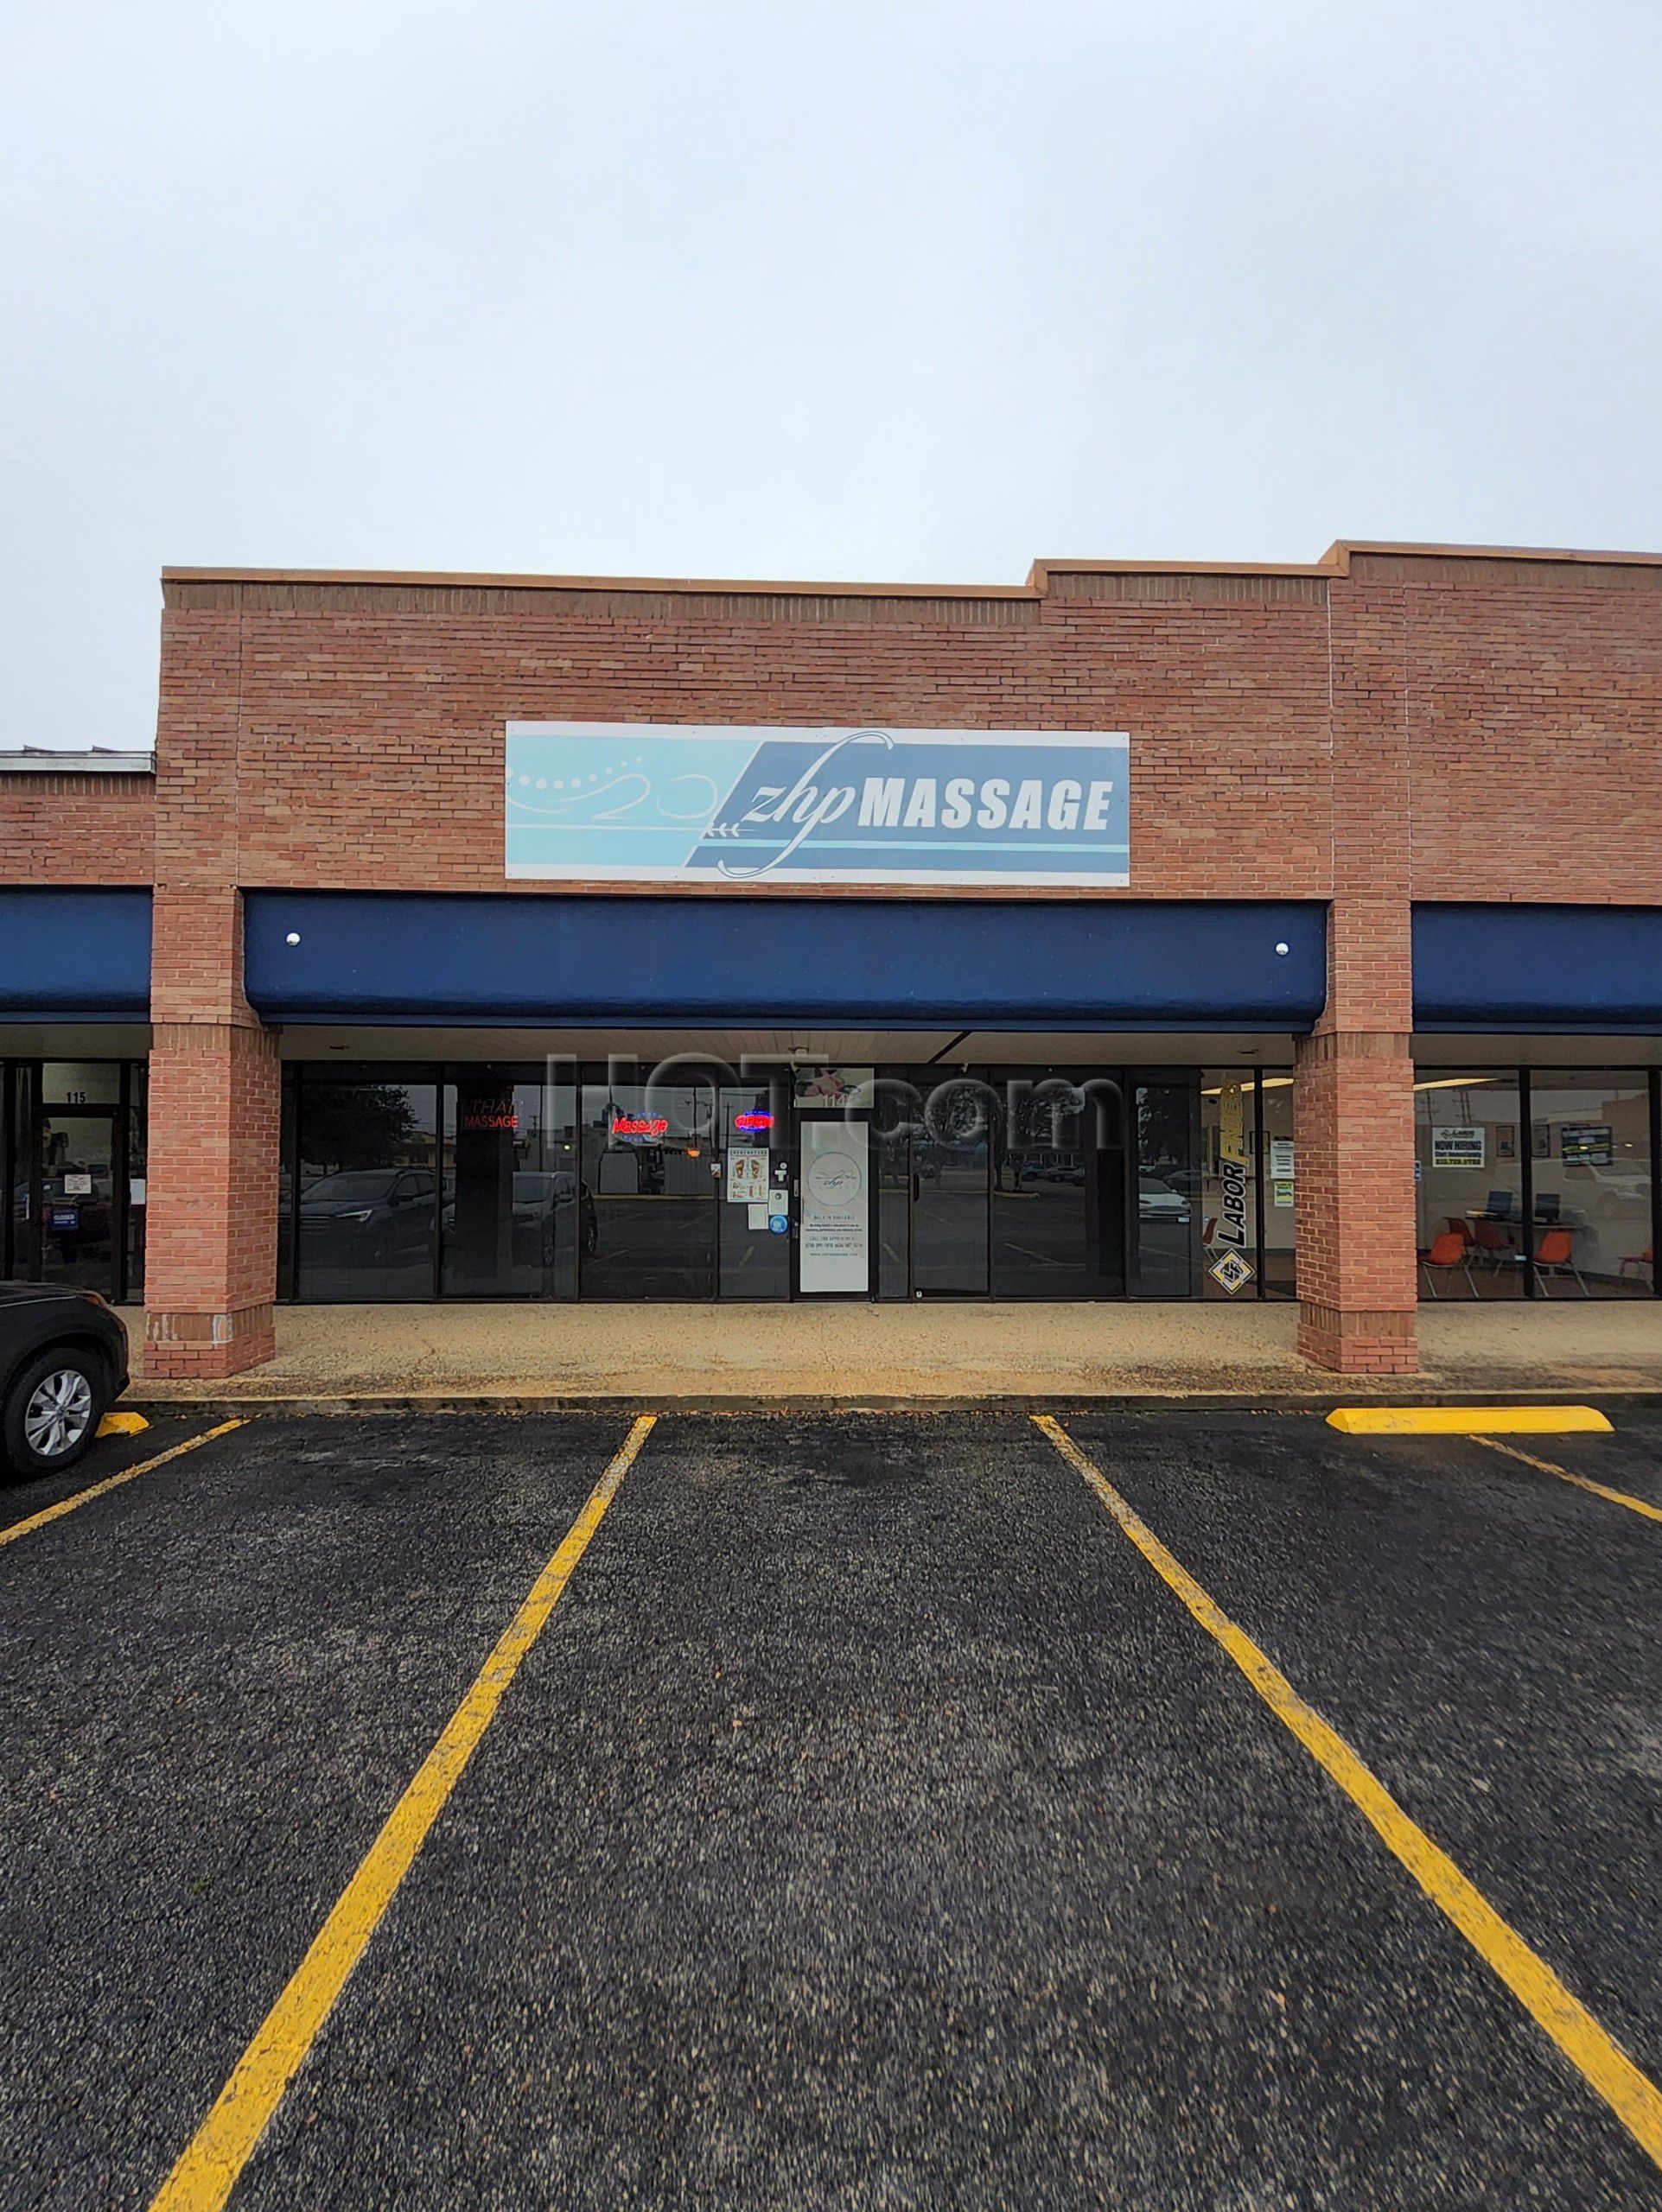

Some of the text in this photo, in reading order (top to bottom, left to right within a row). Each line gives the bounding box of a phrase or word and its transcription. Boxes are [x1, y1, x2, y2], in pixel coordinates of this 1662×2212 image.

[717, 731, 1115, 878] zhp MASSAGE
[67, 1092, 86, 1103] 115
[465, 1116, 519, 1128] MASSAGE
[612, 1117, 668, 1136] Massage
[1217, 1163, 1246, 1248] LABOR
